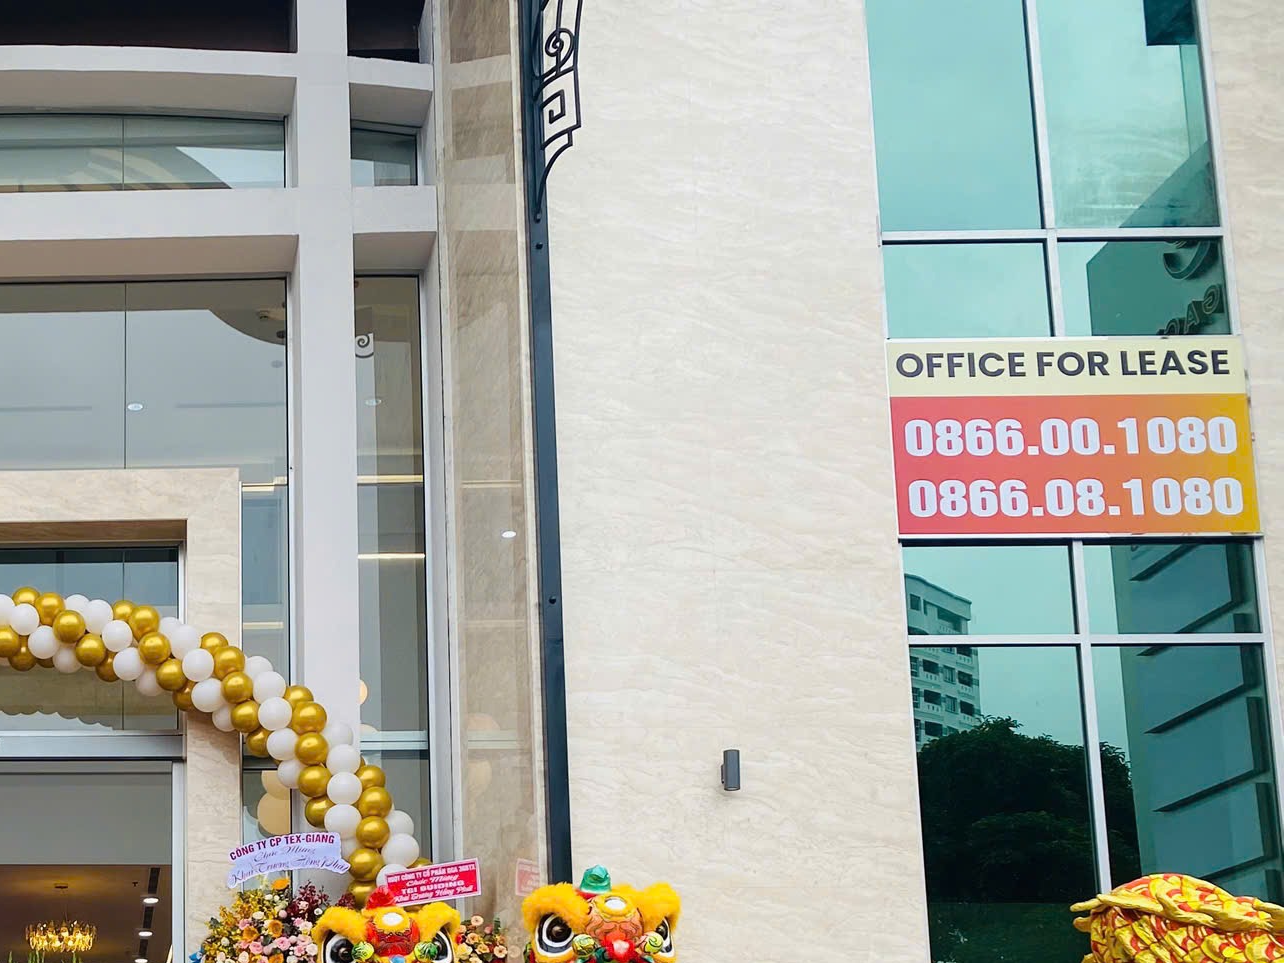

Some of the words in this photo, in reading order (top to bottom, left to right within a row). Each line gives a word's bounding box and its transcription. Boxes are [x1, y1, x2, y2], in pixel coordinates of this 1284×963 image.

[895, 351, 1027, 378] OFFICE
[1037, 350, 1109, 376] FOR
[1120, 349, 1230, 376] LEASE
[903, 415, 1238, 457] 0866.00.1080
[907, 476, 1244, 518] 0866.08.1080
[256, 840, 267, 851] TY
[269, 837, 282, 848] CP
[284, 833, 335, 845] TEX-GIANG
